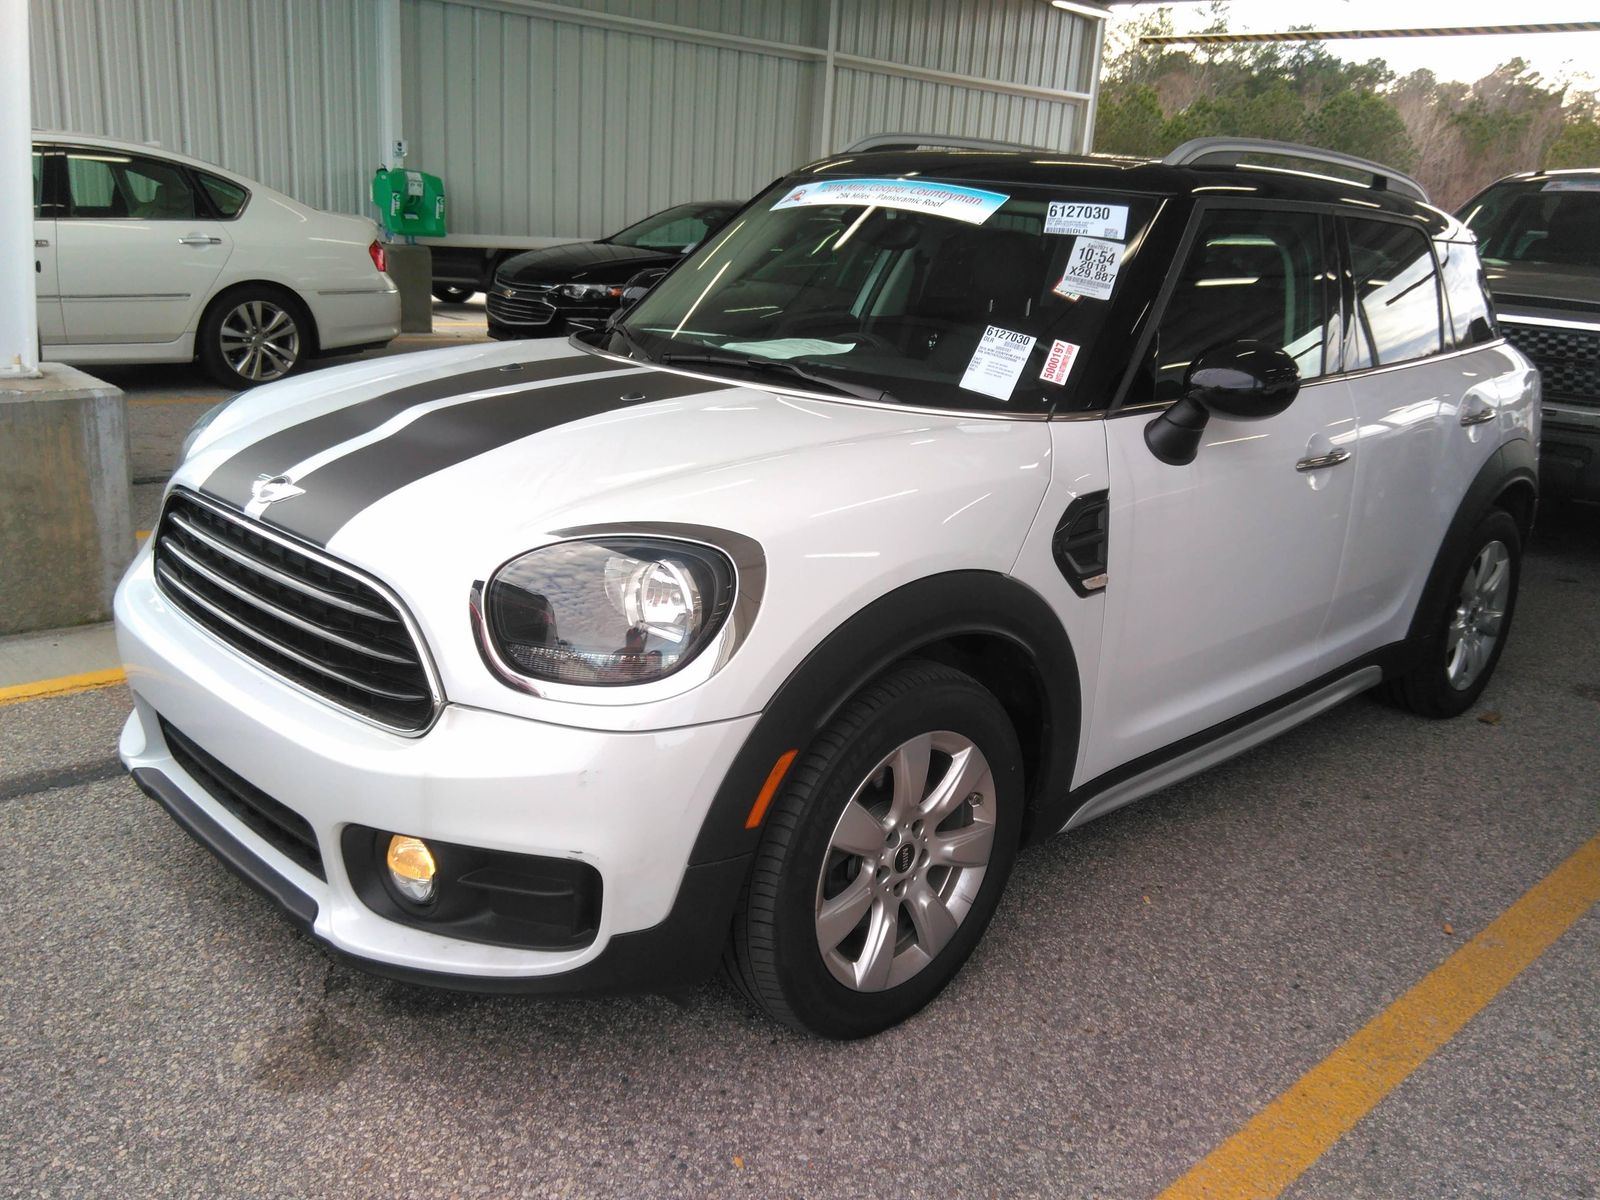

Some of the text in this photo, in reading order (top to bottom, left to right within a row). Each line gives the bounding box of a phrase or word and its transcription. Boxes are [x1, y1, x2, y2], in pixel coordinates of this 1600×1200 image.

[869, 184, 906, 194] Cooper
[910, 187, 983, 205] Countryman
[922, 199, 947, 208] Roof
[1049, 204, 1110, 220] 6127030
[1079, 247, 1116, 266] 10:54
[1069, 266, 1115, 283] X29,887
[1079, 260, 1107, 272] 2018
[986, 326, 1031, 345] 6127030
[1044, 342, 1065, 379] 5000197
